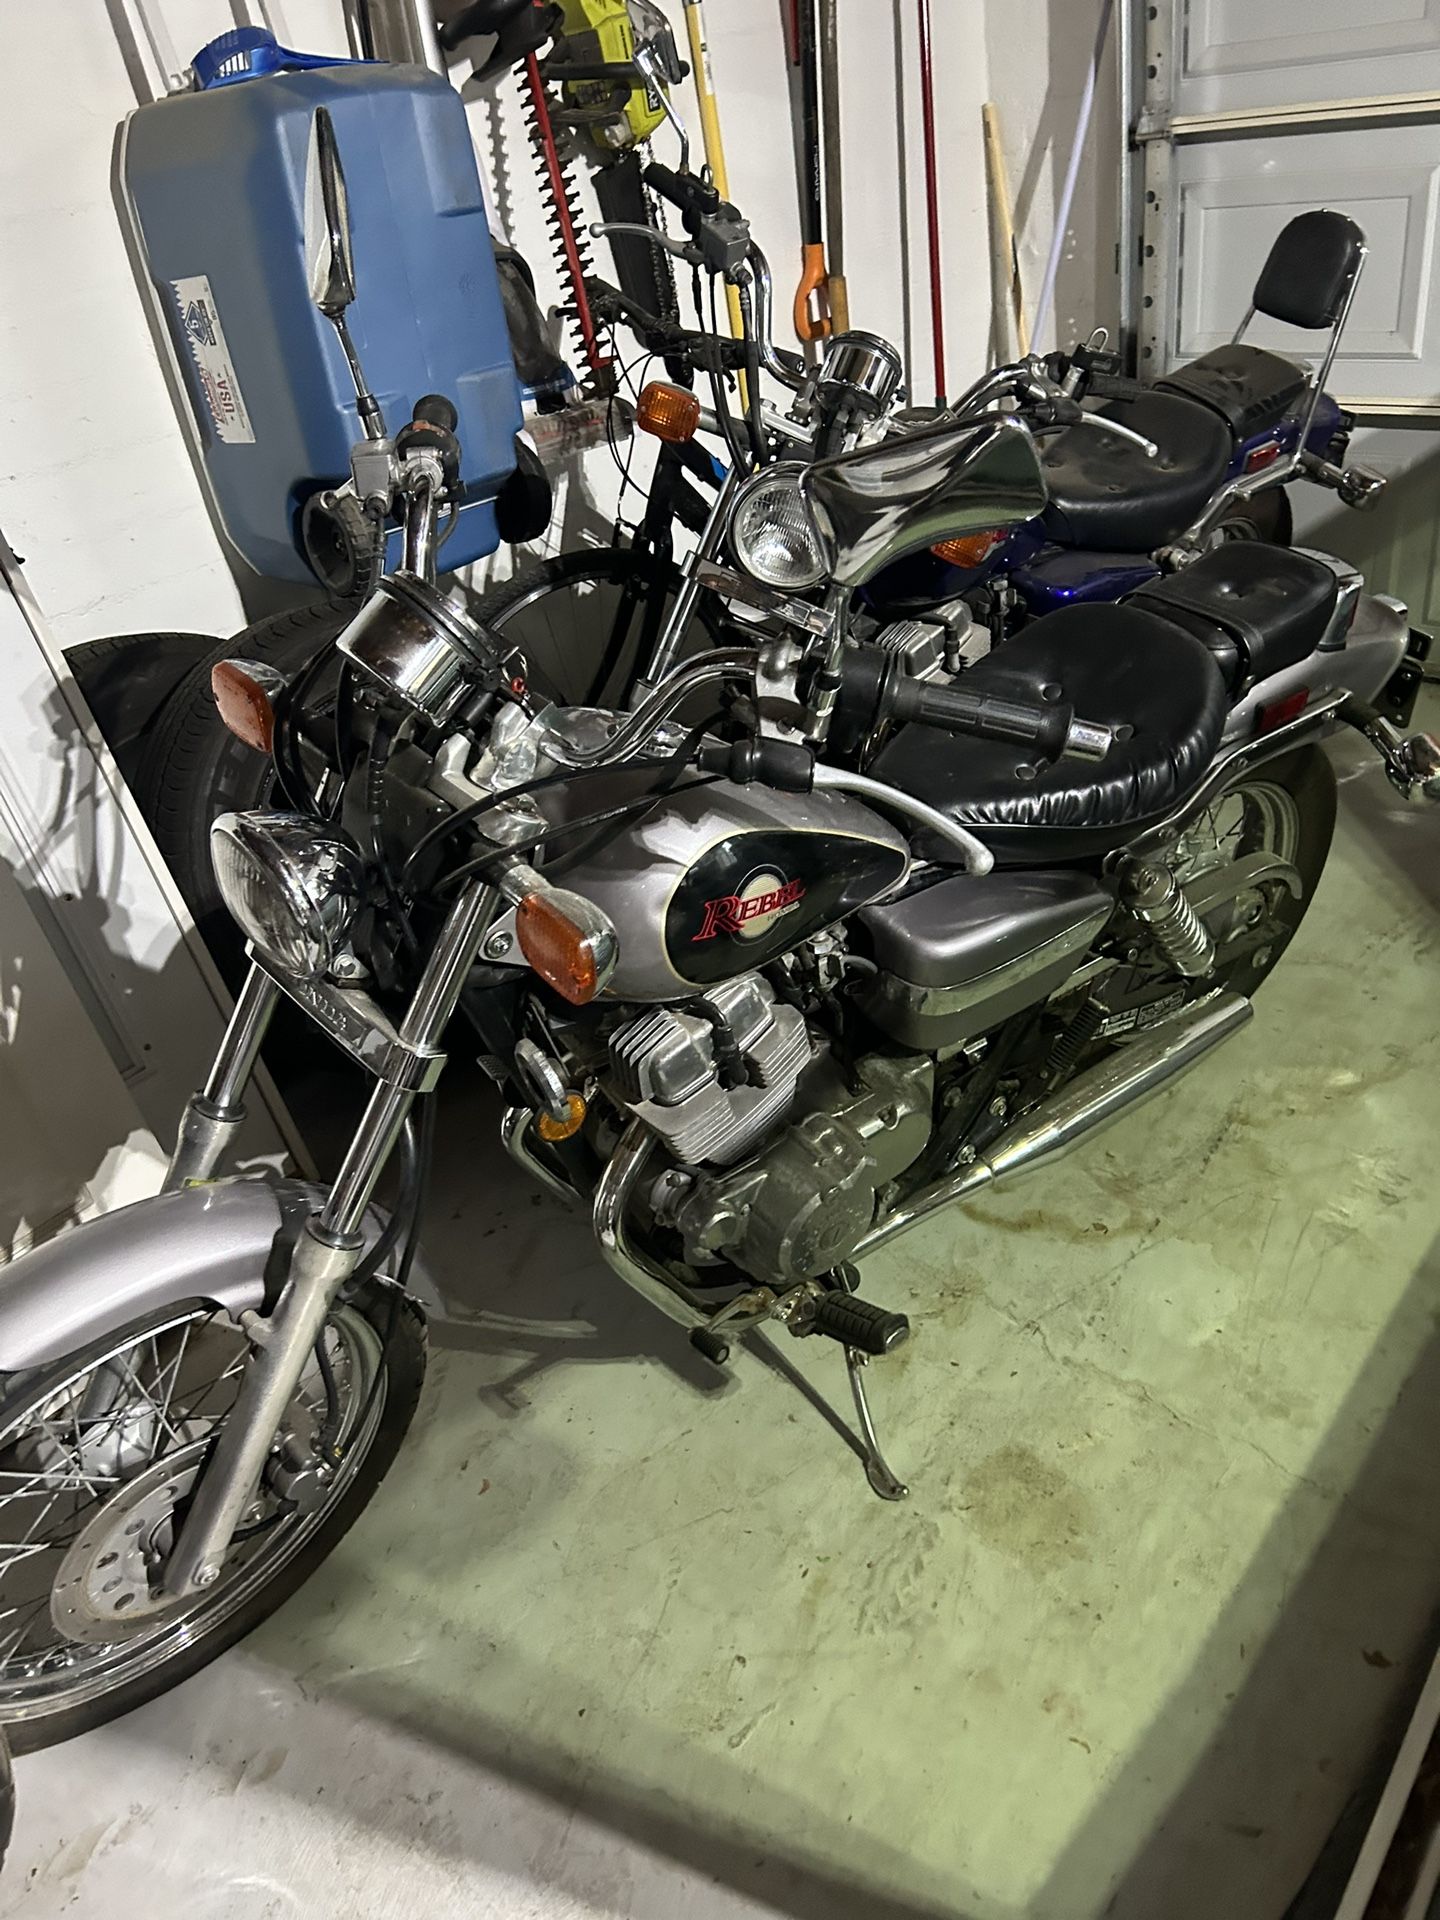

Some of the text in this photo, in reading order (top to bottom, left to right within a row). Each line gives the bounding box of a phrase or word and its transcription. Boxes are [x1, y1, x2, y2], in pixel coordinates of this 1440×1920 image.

[216, 380, 235, 416] USA
[691, 878, 807, 942] REBEL
[296, 981, 348, 1031] ONDA
